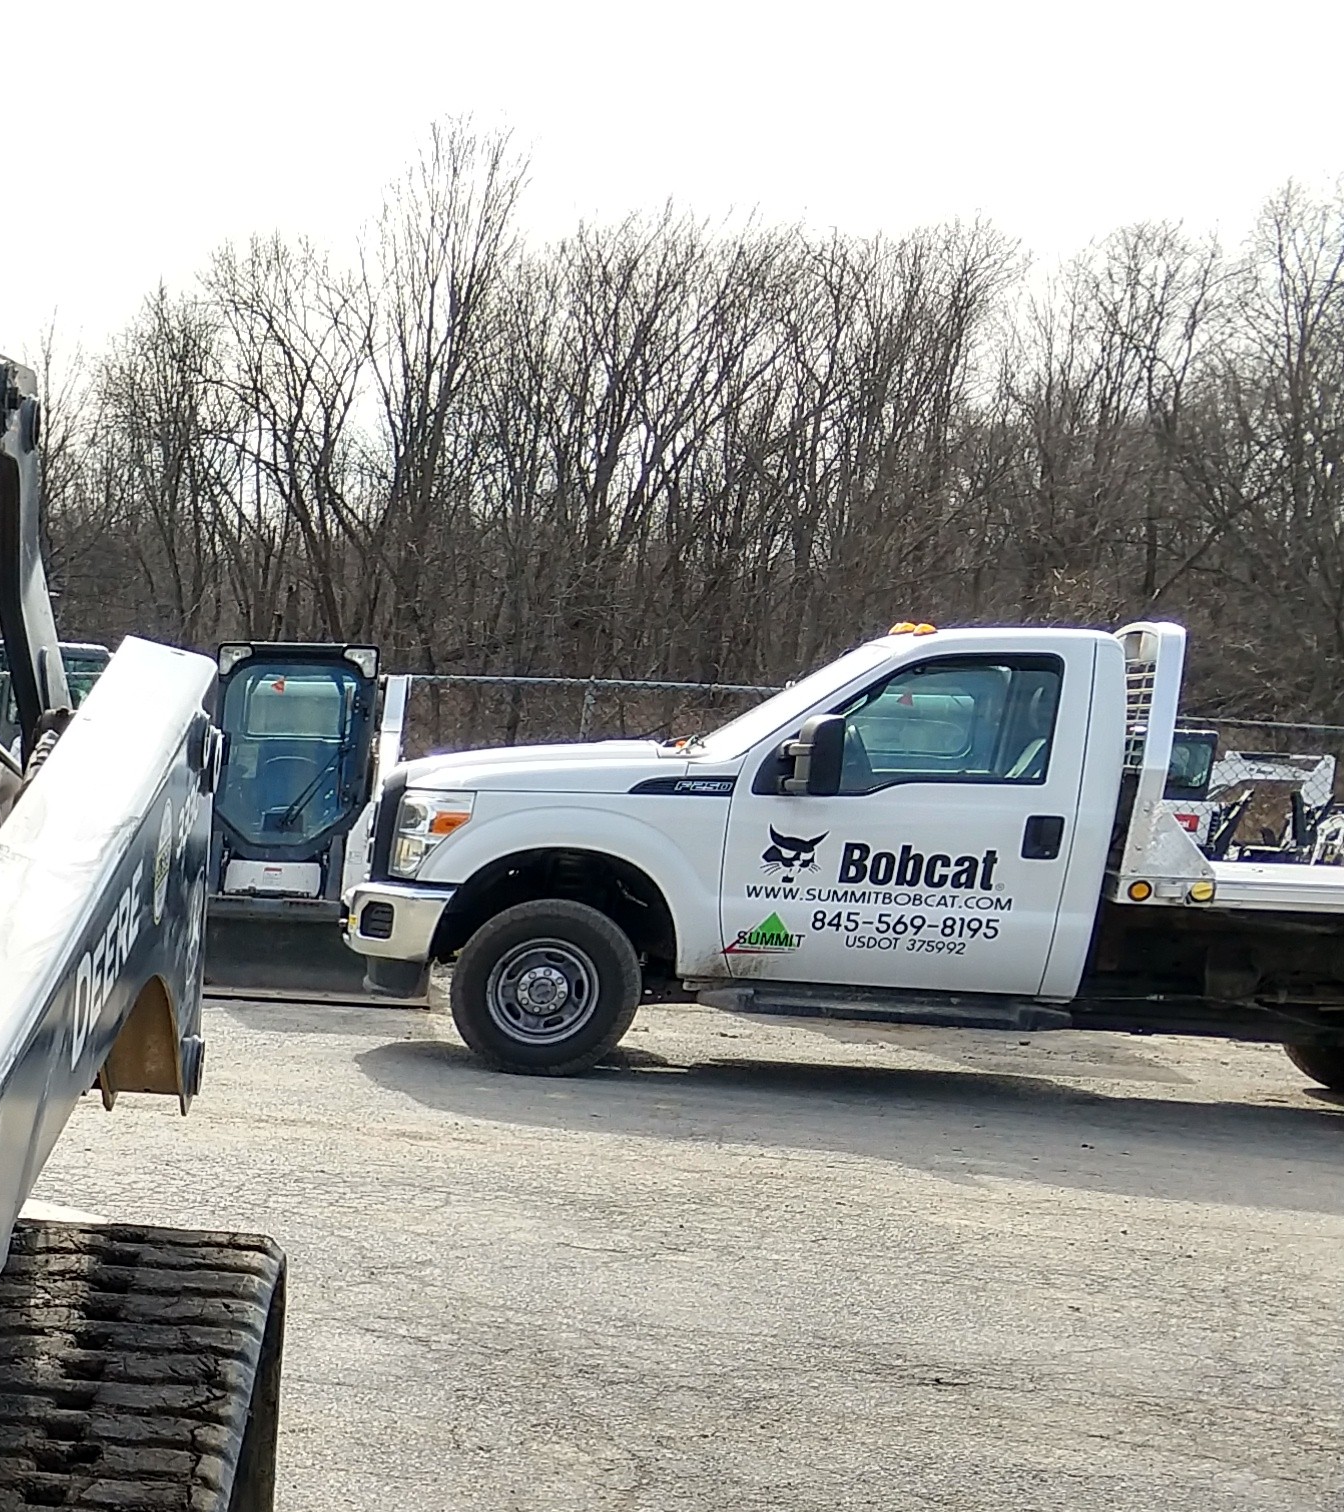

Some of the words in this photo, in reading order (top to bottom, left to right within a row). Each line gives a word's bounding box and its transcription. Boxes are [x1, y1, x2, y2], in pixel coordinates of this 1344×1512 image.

[837, 841, 999, 892] Bobcat
[745, 884, 1013, 912] WWW.SUMMITBOBCAT.COM
[736, 930, 806, 948] SUMMIT
[810, 909, 1001, 940] 845-569-8195
[844, 934, 901, 951] USDOT
[905, 938, 967, 956] 375992
[71, 857, 144, 1072] DEERE
